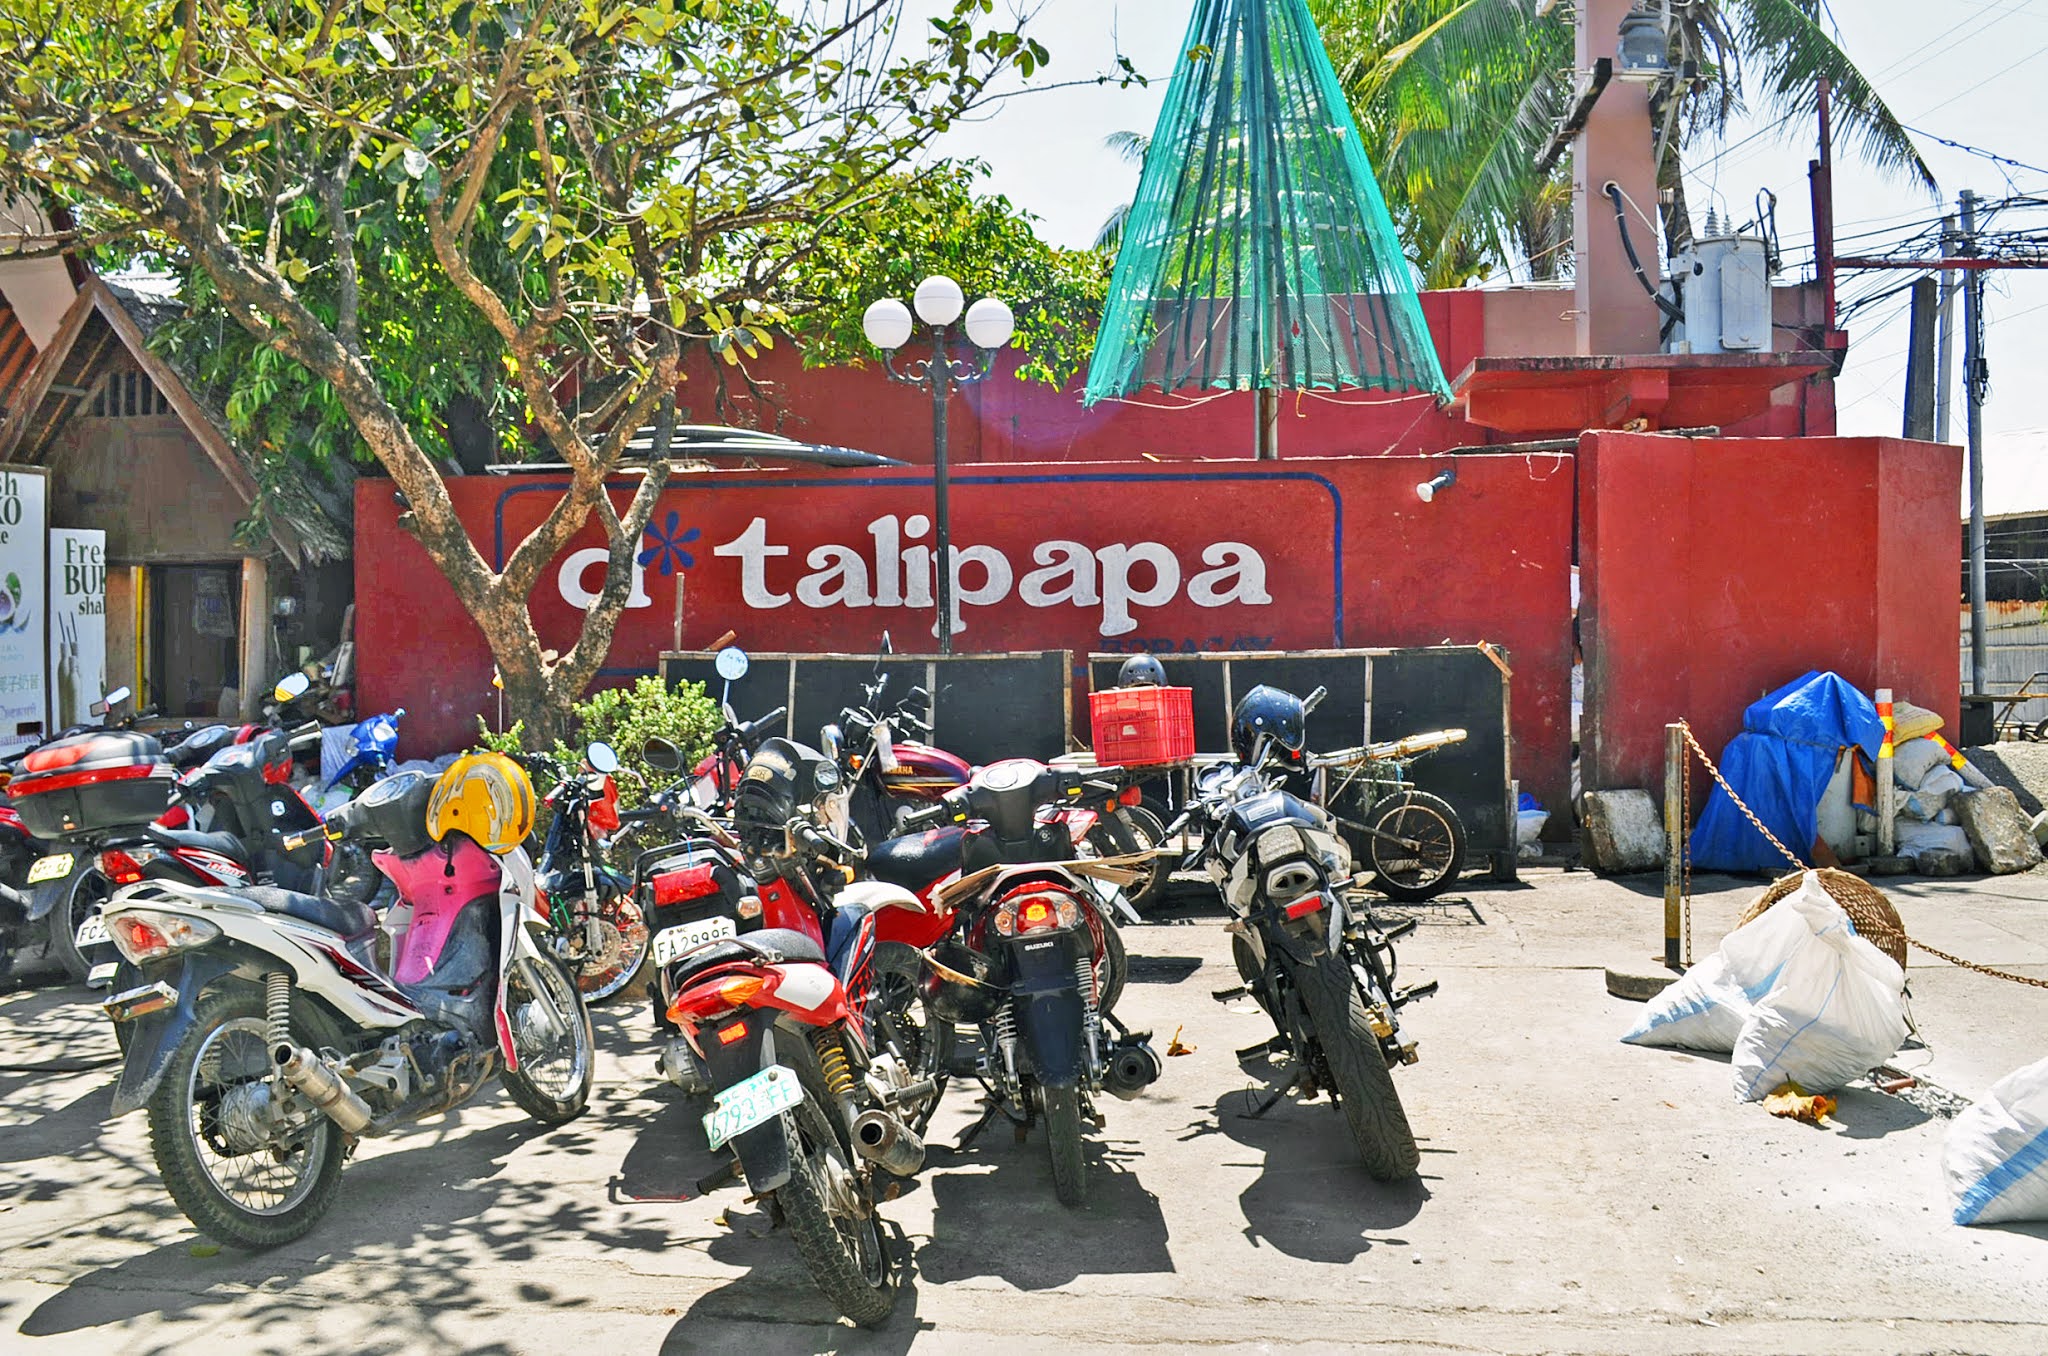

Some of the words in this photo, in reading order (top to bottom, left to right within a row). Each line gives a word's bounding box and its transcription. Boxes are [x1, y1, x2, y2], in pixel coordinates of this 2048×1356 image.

[714, 514, 1272, 637] talipapa
[1024, 941, 1054, 951] SUZUKI
[711, 1097, 757, 1142] 6793
